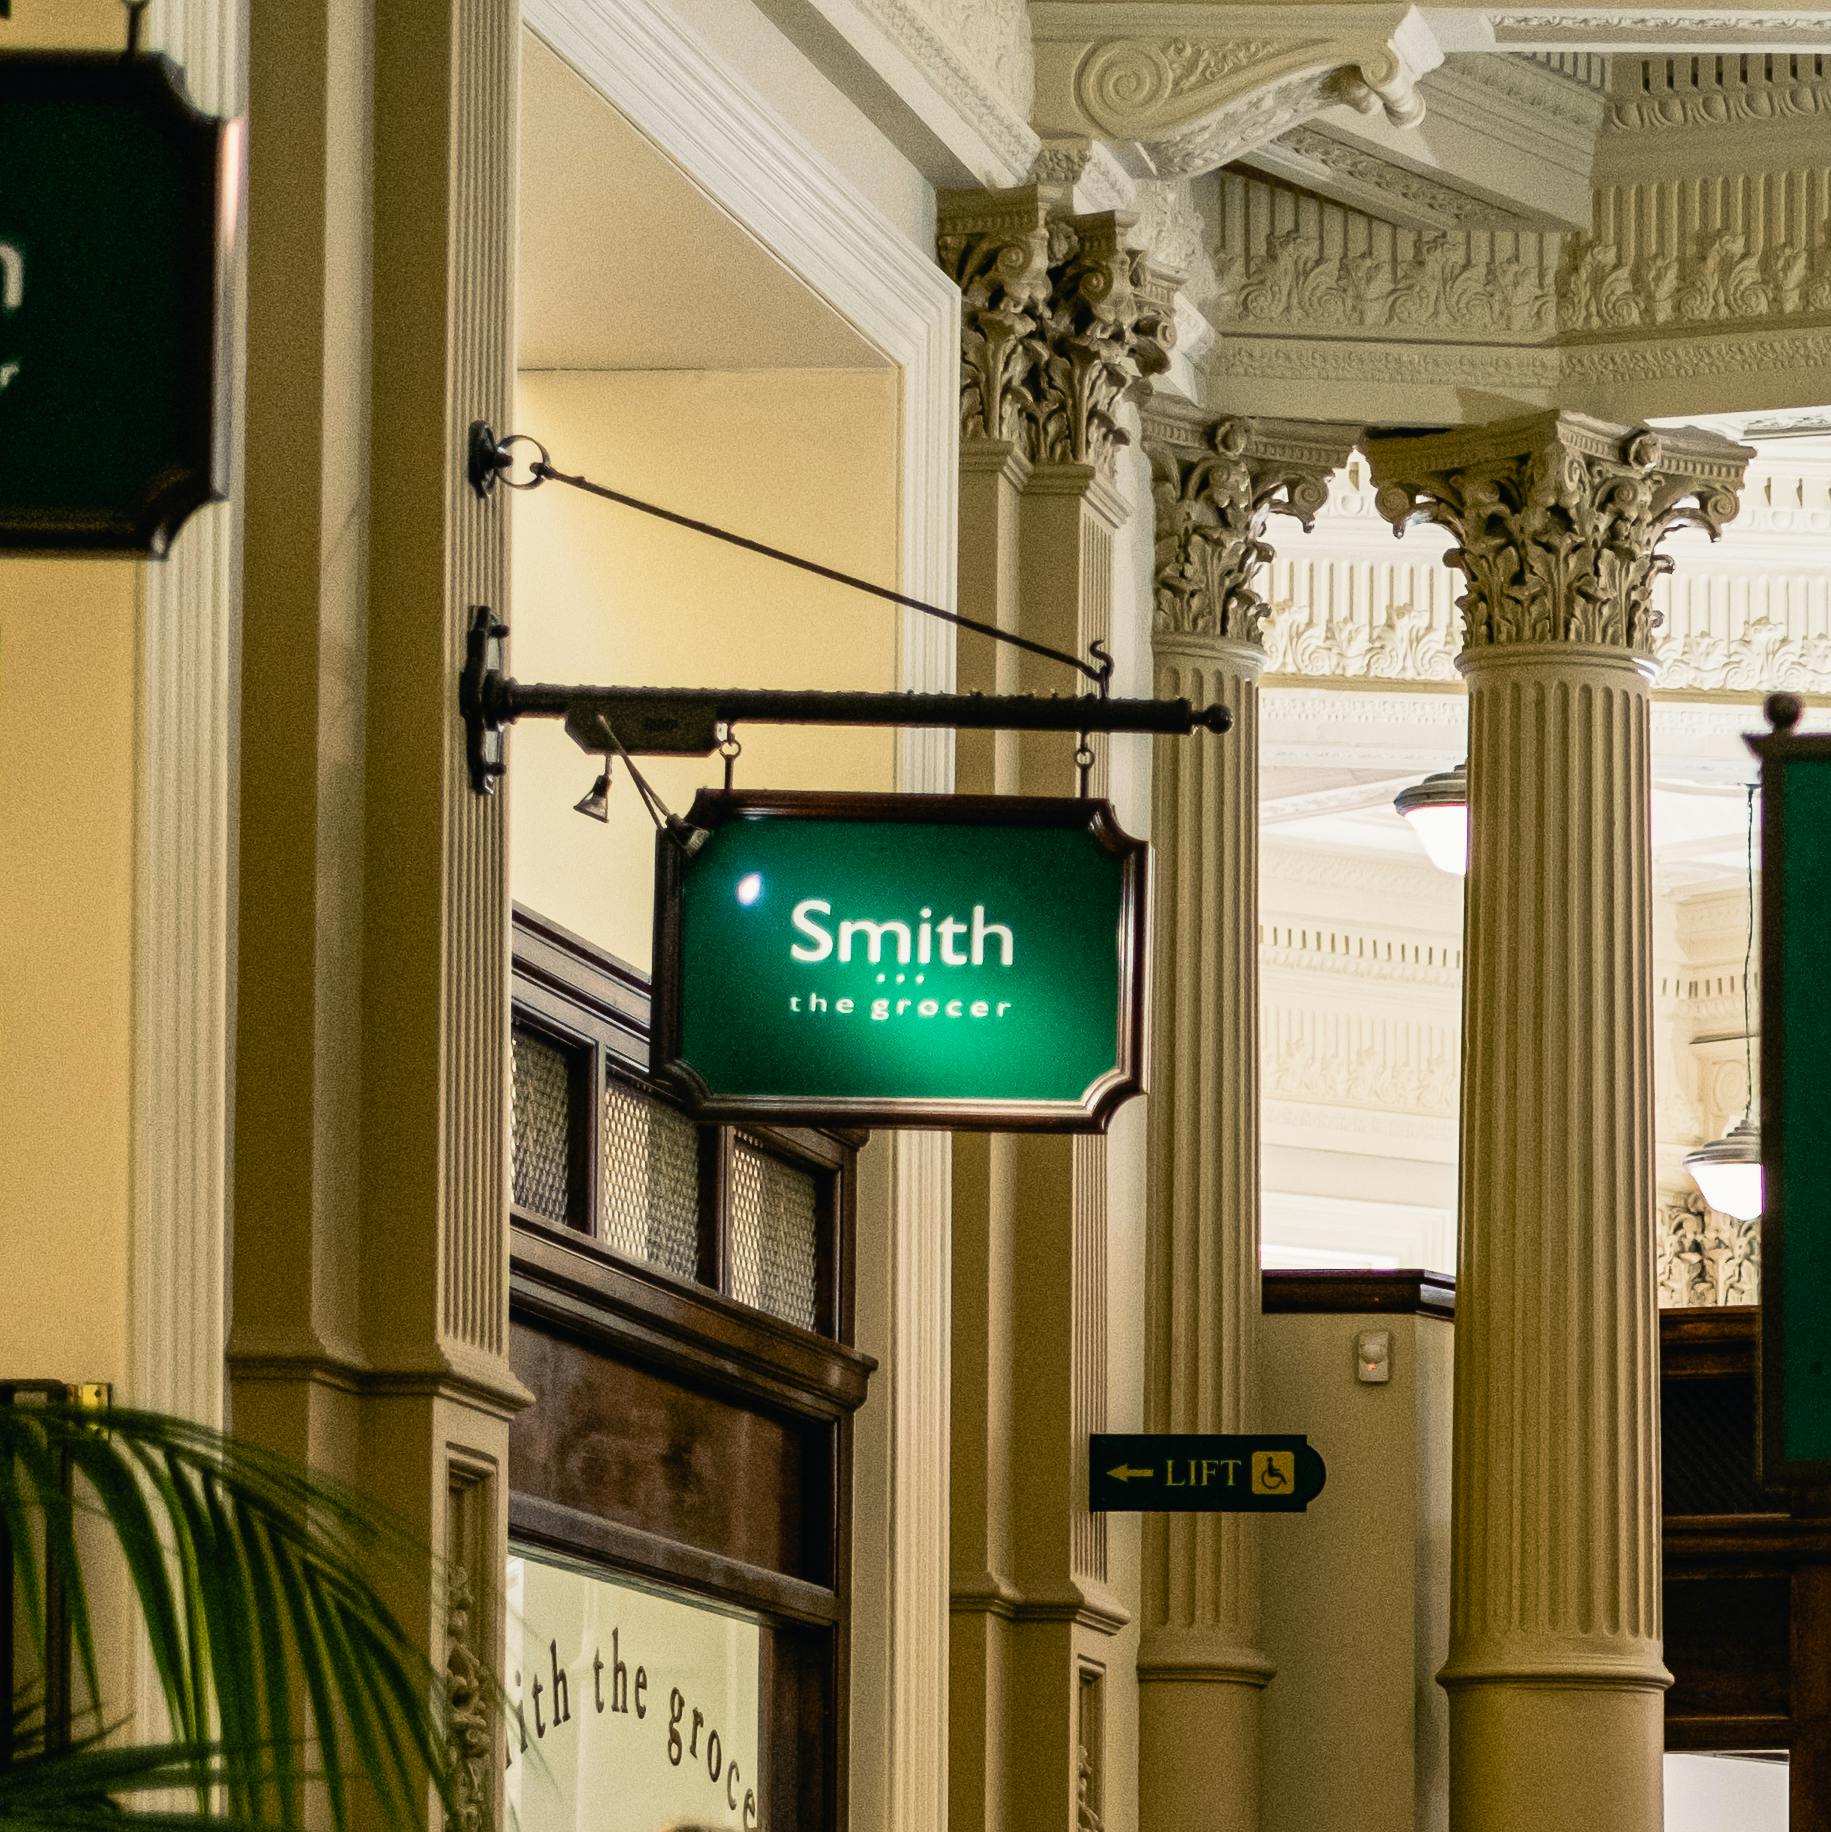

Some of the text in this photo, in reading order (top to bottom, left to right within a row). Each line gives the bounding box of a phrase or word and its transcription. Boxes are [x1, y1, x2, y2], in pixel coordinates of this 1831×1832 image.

[789, 899, 1014, 967] Smith
[789, 992, 1012, 1021] the grocer
[1164, 1457, 1241, 1487] LIFT
[506, 1639, 571, 1768] ith
[593, 1627, 648, 1719] the
